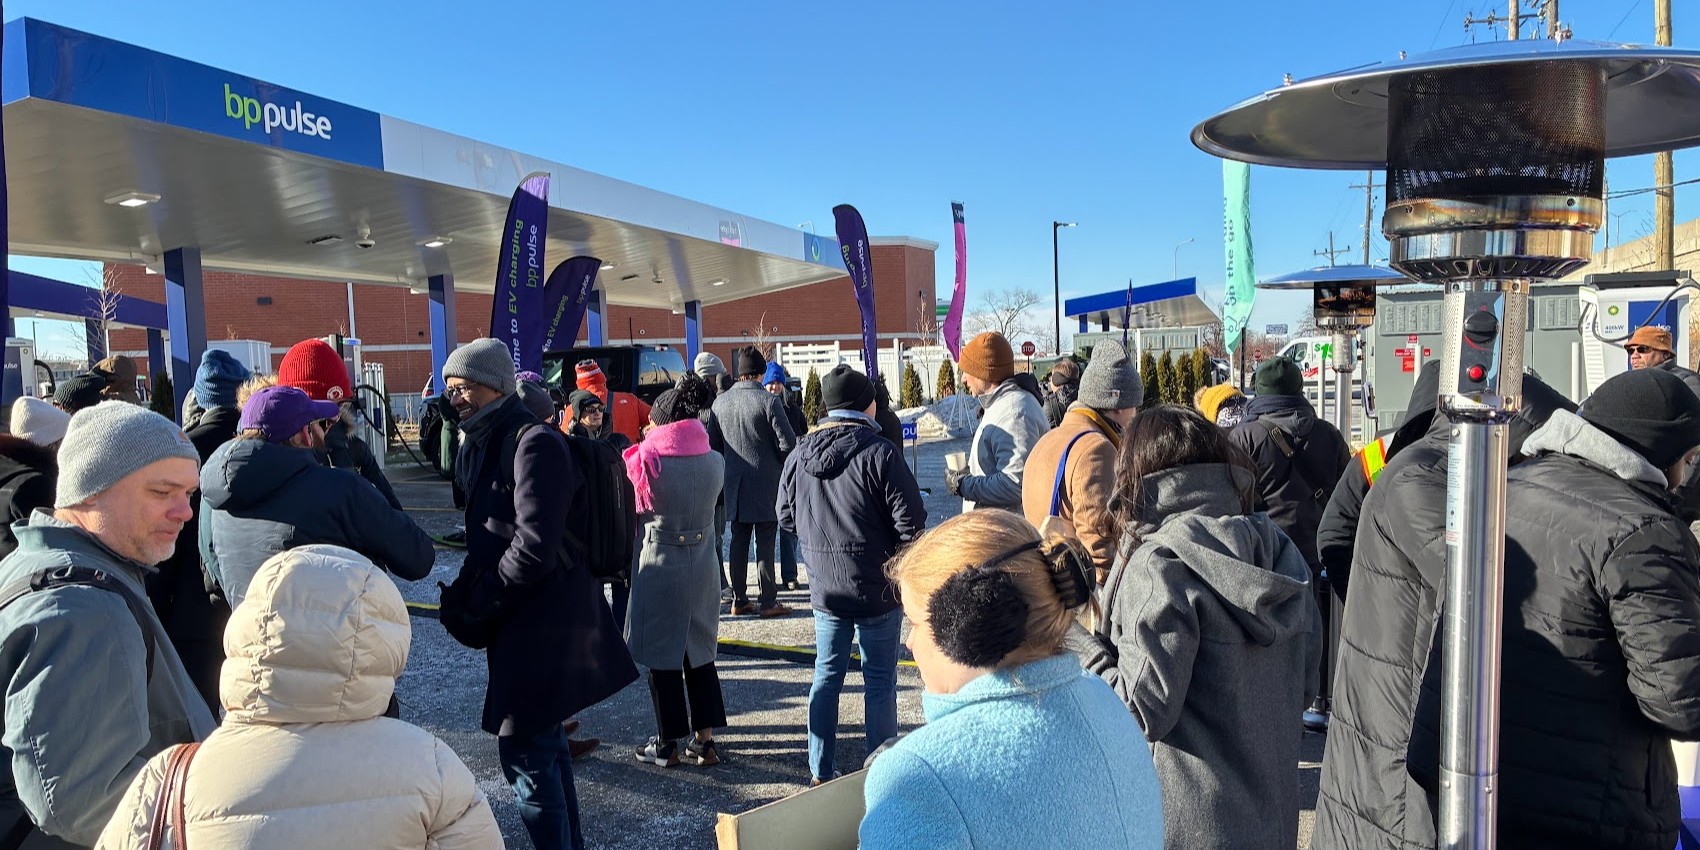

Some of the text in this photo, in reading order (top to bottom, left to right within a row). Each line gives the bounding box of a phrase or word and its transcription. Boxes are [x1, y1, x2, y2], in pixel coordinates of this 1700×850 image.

[1228, 219, 1235, 242] go
[509, 219, 523, 289] charging
[509, 291, 517, 314] EV
[511, 319, 519, 334] to
